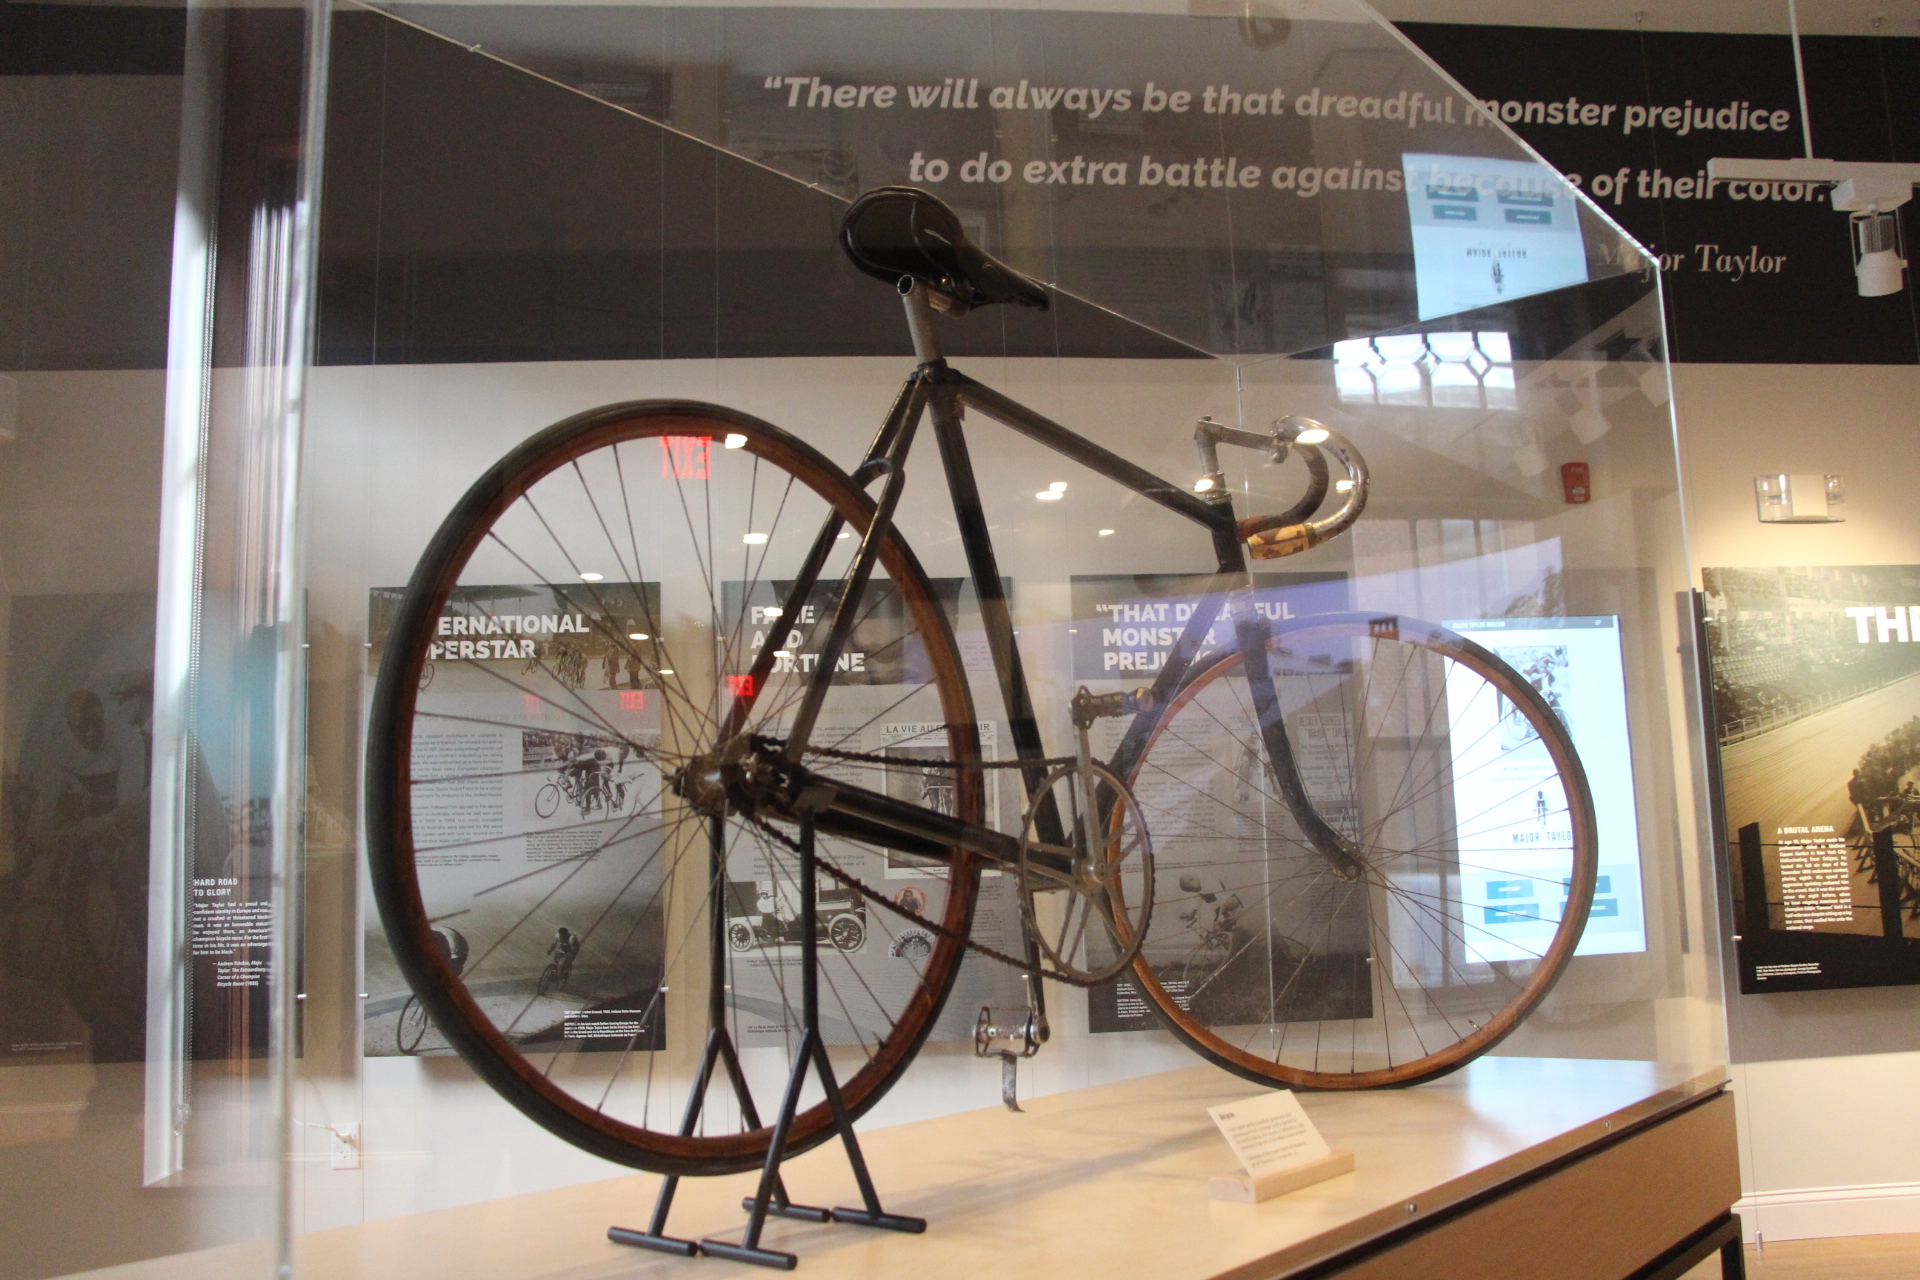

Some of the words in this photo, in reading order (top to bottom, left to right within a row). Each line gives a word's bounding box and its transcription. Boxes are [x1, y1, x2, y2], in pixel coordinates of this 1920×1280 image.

[907, 78, 979, 109] will
[989, 79, 1132, 119] always
[1142, 82, 1191, 113] be
[1203, 85, 1284, 115] that
[1295, 87, 1455, 128] dreadful
[1465, 97, 1616, 126] monster
[1623, 99, 1790, 136] prejudice
[909, 152, 949, 182] to
[959, 152, 1012, 183] do
[1023, 155, 1128, 185] extra
[1139, 155, 1261, 188] battle
[1272, 160, 1417, 198] against
[1430, 164, 1582, 198] because
[1591, 168, 1631, 205] of
[1637, 169, 1720, 199] their
[1694, 244, 1787, 282] Taylor
[750, 629, 806, 649] AD
[1513, 833, 1540, 843] MAJOR
[1547, 831, 1572, 841] TAYLO
[206, 888, 231, 896] GLORY
[218, 878, 238, 886] ROAD
